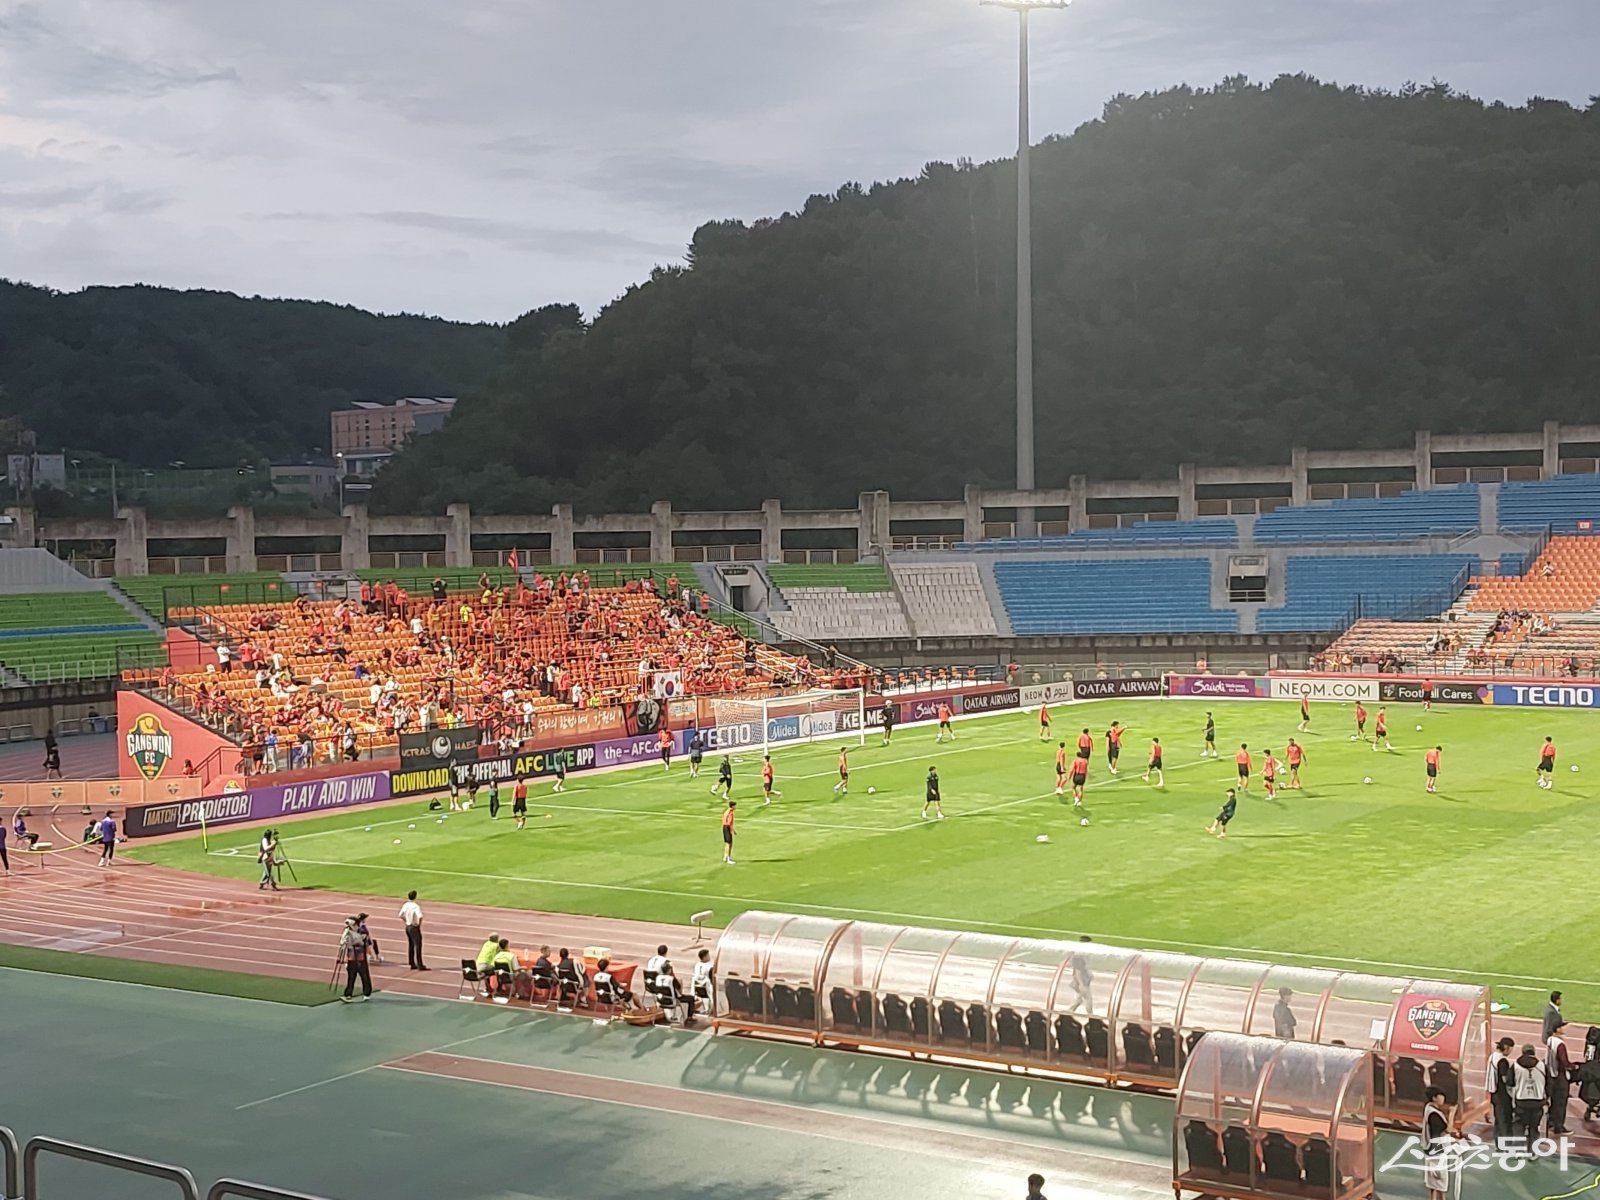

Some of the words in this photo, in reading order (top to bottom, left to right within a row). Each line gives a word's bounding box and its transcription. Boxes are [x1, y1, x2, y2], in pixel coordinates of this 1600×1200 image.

[1024, 690, 1043, 701] NEOM
[1077, 682, 1116, 695] QATAR
[1119, 681, 1162, 693] AIRWAY
[1279, 682, 1370, 697] NEOM.COM
[1398, 687, 1440, 699] Footall
[1441, 688, 1473, 700] Cares
[1512, 686, 1593, 706] TECNO
[964, 695, 988, 710] QATAR
[989, 692, 1019, 707] AIRWAYS
[699, 724, 751, 747] TECNO
[770, 723, 797, 738] Midea
[126, 734, 172, 759] GANGWON
[145, 751, 156, 764] FC
[392, 767, 449, 795] DOWNLOAD
[472, 759, 513, 782] OFFICIAL
[514, 755, 544, 775] AFC
[576, 747, 595, 766] APP
[282, 784, 317, 812] PLAY
[317, 780, 347, 806] AND
[350, 776, 377, 801] WIN
[146, 807, 178, 827] MATCH
[181, 795, 249, 823] PREDICTOR
[1408, 1008, 1457, 1026] GANGWON
[1423, 1020, 1436, 1028] FC
